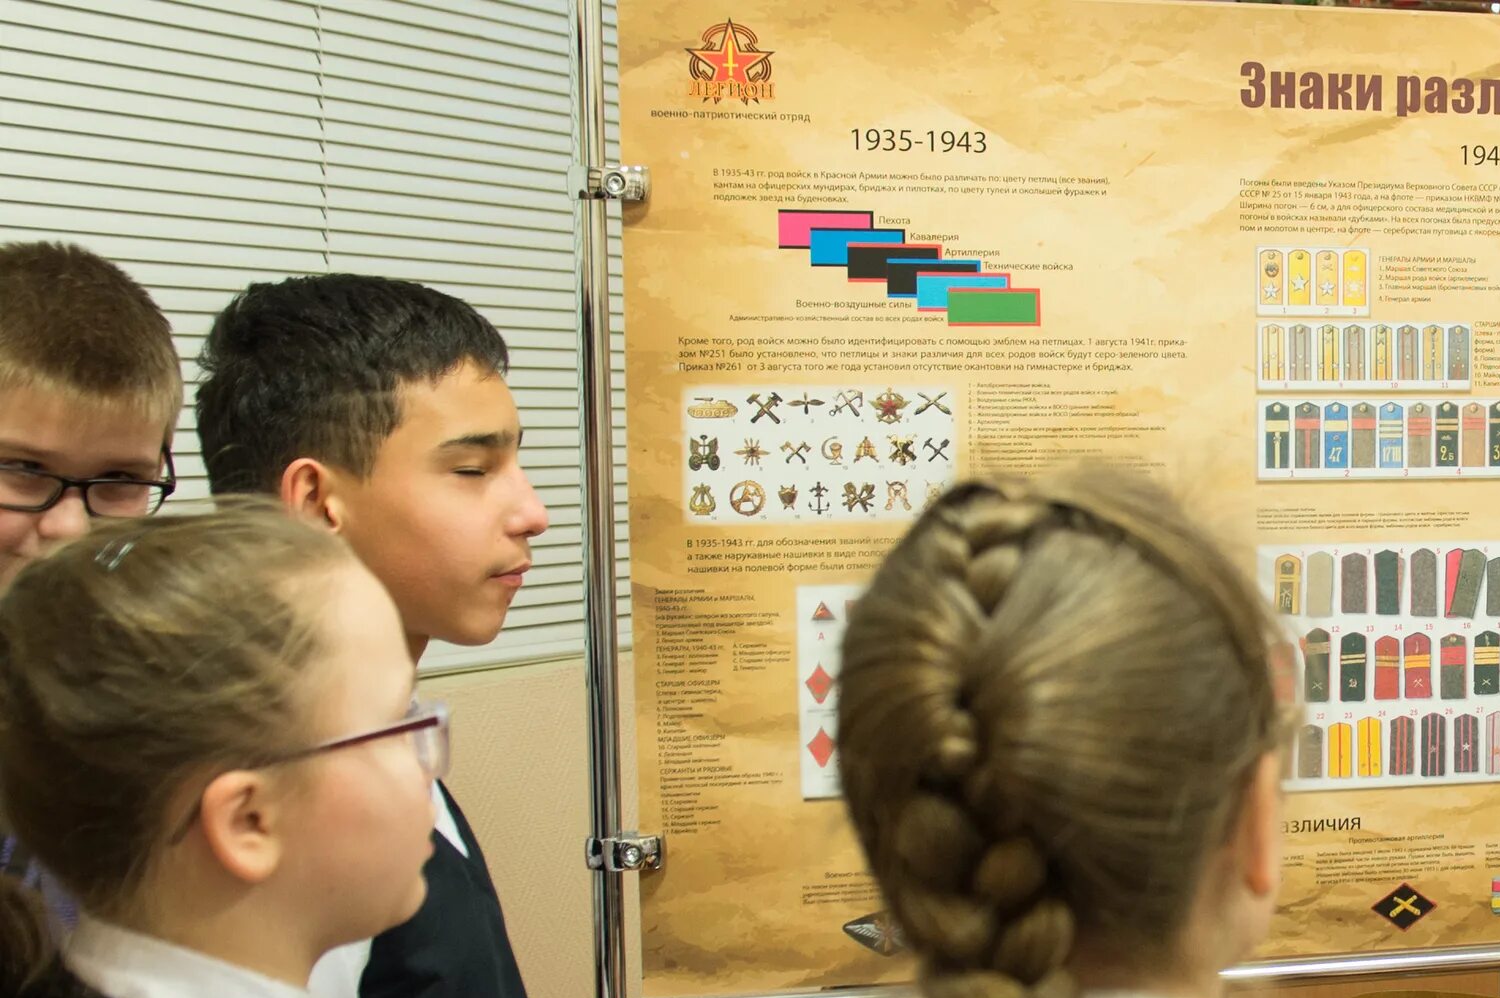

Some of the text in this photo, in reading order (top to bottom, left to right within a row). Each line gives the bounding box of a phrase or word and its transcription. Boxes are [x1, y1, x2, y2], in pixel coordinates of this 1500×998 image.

[688, 79, 776, 100] ЛЕГИОН
[1239, 61, 1383, 112] Знаки
[650, 109, 811, 123] военно-патриотический отряд
[851, 128, 987, 154] 1935-1943
[722, 169, 755, 178] 1935-43
[767, 171, 785, 181] род
[786, 170, 812, 179] войск
[820, 170, 857, 182] Красной
[859, 171, 888, 182] Армии
[919, 172, 942, 182] было
[943, 175, 987, 184] различать
[1002, 176, 1026, 185] цвету
[1028, 176, 1058, 185] петлиц
[1058, 175, 1076, 186] (все
[713, 194, 757, 203] подложек
[759, 195, 784, 203] звезд
[878, 215, 911, 225] Пехота
[909, 232, 960, 243] Кавалерия
[944, 248, 1001, 259] Артиллерия
[984, 261, 1074, 271] Технические войска
[795, 299, 887, 312] Военно-воздушные
[678, 337, 709, 348] Кроме
[712, 339, 736, 348] того,
[736, 339, 755, 348] род
[757, 337, 785, 346] войск
[821, 337, 846, 346] было
[847, 337, 937, 348] идентифицировать
[946, 340, 991, 348] помощью
[993, 338, 1027, 346] эмблем
[1042, 340, 1085, 348] петлицах.
[1095, 340, 1128, 349] августа
[1131, 338, 1157, 347] 1941г.
[1158, 340, 1186, 349] прика-
[699, 350, 726, 359] №251
[729, 350, 754, 359] было
[756, 352, 820, 361] установлено,
[839, 352, 880, 360] петлицы
[920, 352, 964, 361] различия
[966, 352, 983, 360] для
[1008, 352, 1036, 361] родов
[1038, 350, 1065, 359] войск
[1067, 350, 1092, 361] будут
[1094, 352, 1159, 361] серо-зеленого
[1161, 352, 1187, 360] цвета.
[1328, 446, 1343, 463] 47
[696, 538, 743, 548] 1935-1943
[756, 540, 774, 548] для
[775, 537, 837, 547] обозначения
[839, 536, 872, 546] званий
[744, 563, 785, 573] полевой
[786, 562, 818, 574] форме
[819, 562, 844, 571] были
[1280, 816, 1361, 834] азличия
